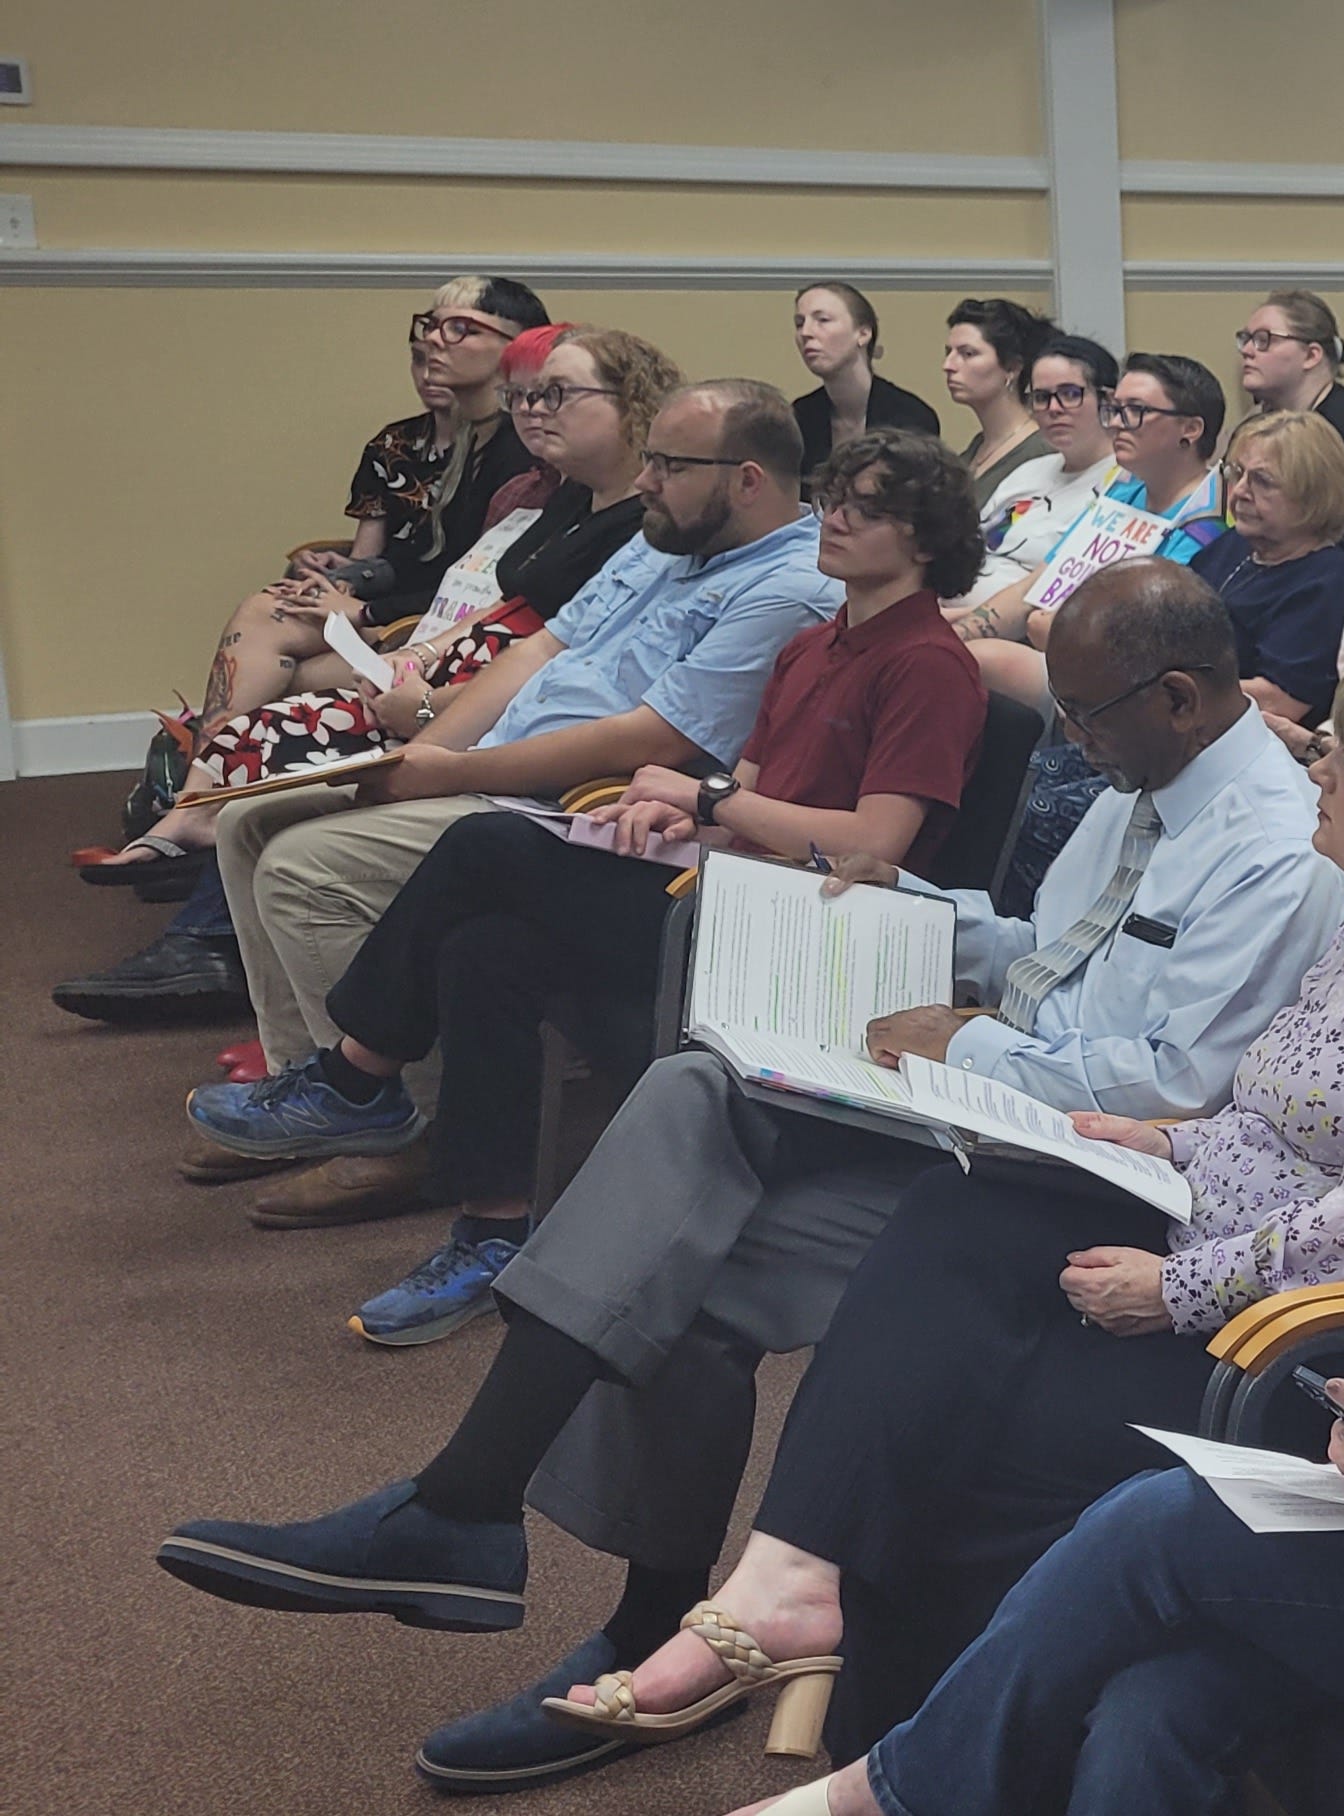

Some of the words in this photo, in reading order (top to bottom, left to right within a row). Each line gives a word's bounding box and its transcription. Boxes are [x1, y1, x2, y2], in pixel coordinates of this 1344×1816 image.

[1091, 505, 1125, 532] WE
[1120, 517, 1159, 545] ARE
[1082, 533, 1136, 564] NOT
